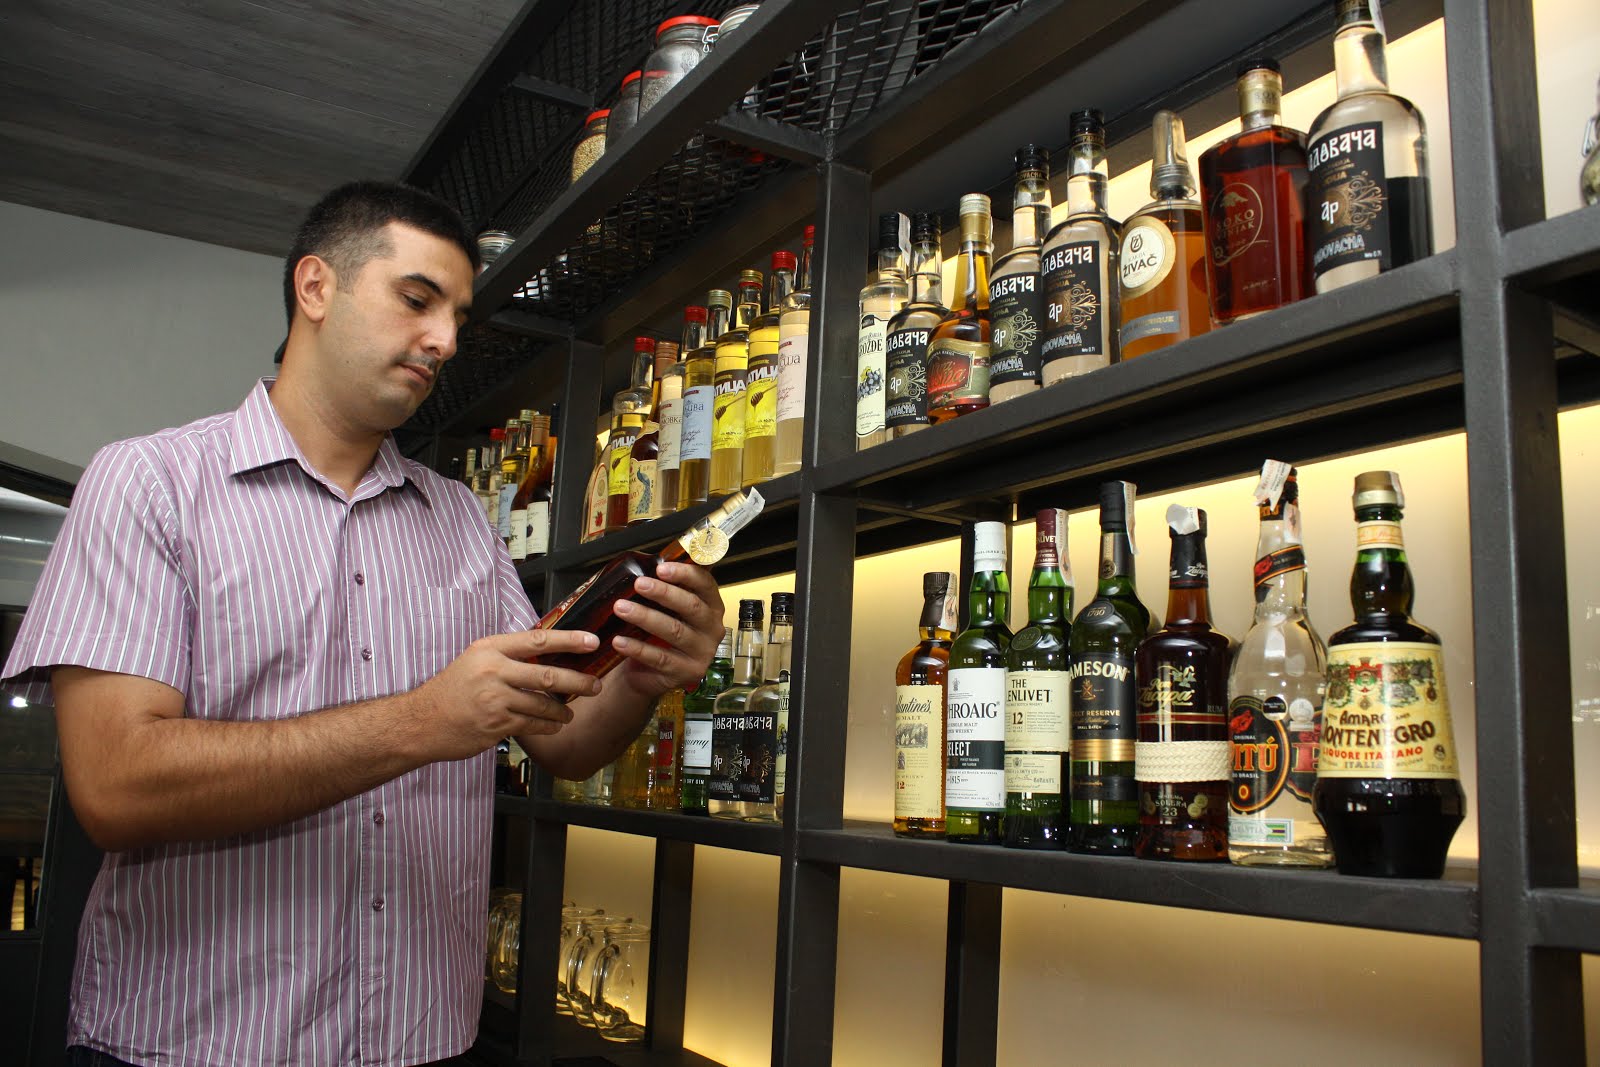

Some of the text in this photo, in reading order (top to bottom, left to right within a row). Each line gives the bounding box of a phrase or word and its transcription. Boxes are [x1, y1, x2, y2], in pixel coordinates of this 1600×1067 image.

[1122, 253, 1158, 278] ŽIVAČ
[1012, 679, 1027, 688] THE
[1086, 709, 1120, 717] RESERVE
[1207, 704, 1223, 713] RUM
[1012, 711, 1023, 725] 12
[1322, 746, 1360, 760] LIQUORE
[1155, 799, 1187, 809] SOLERA
[1162, 807, 1178, 817] 23
